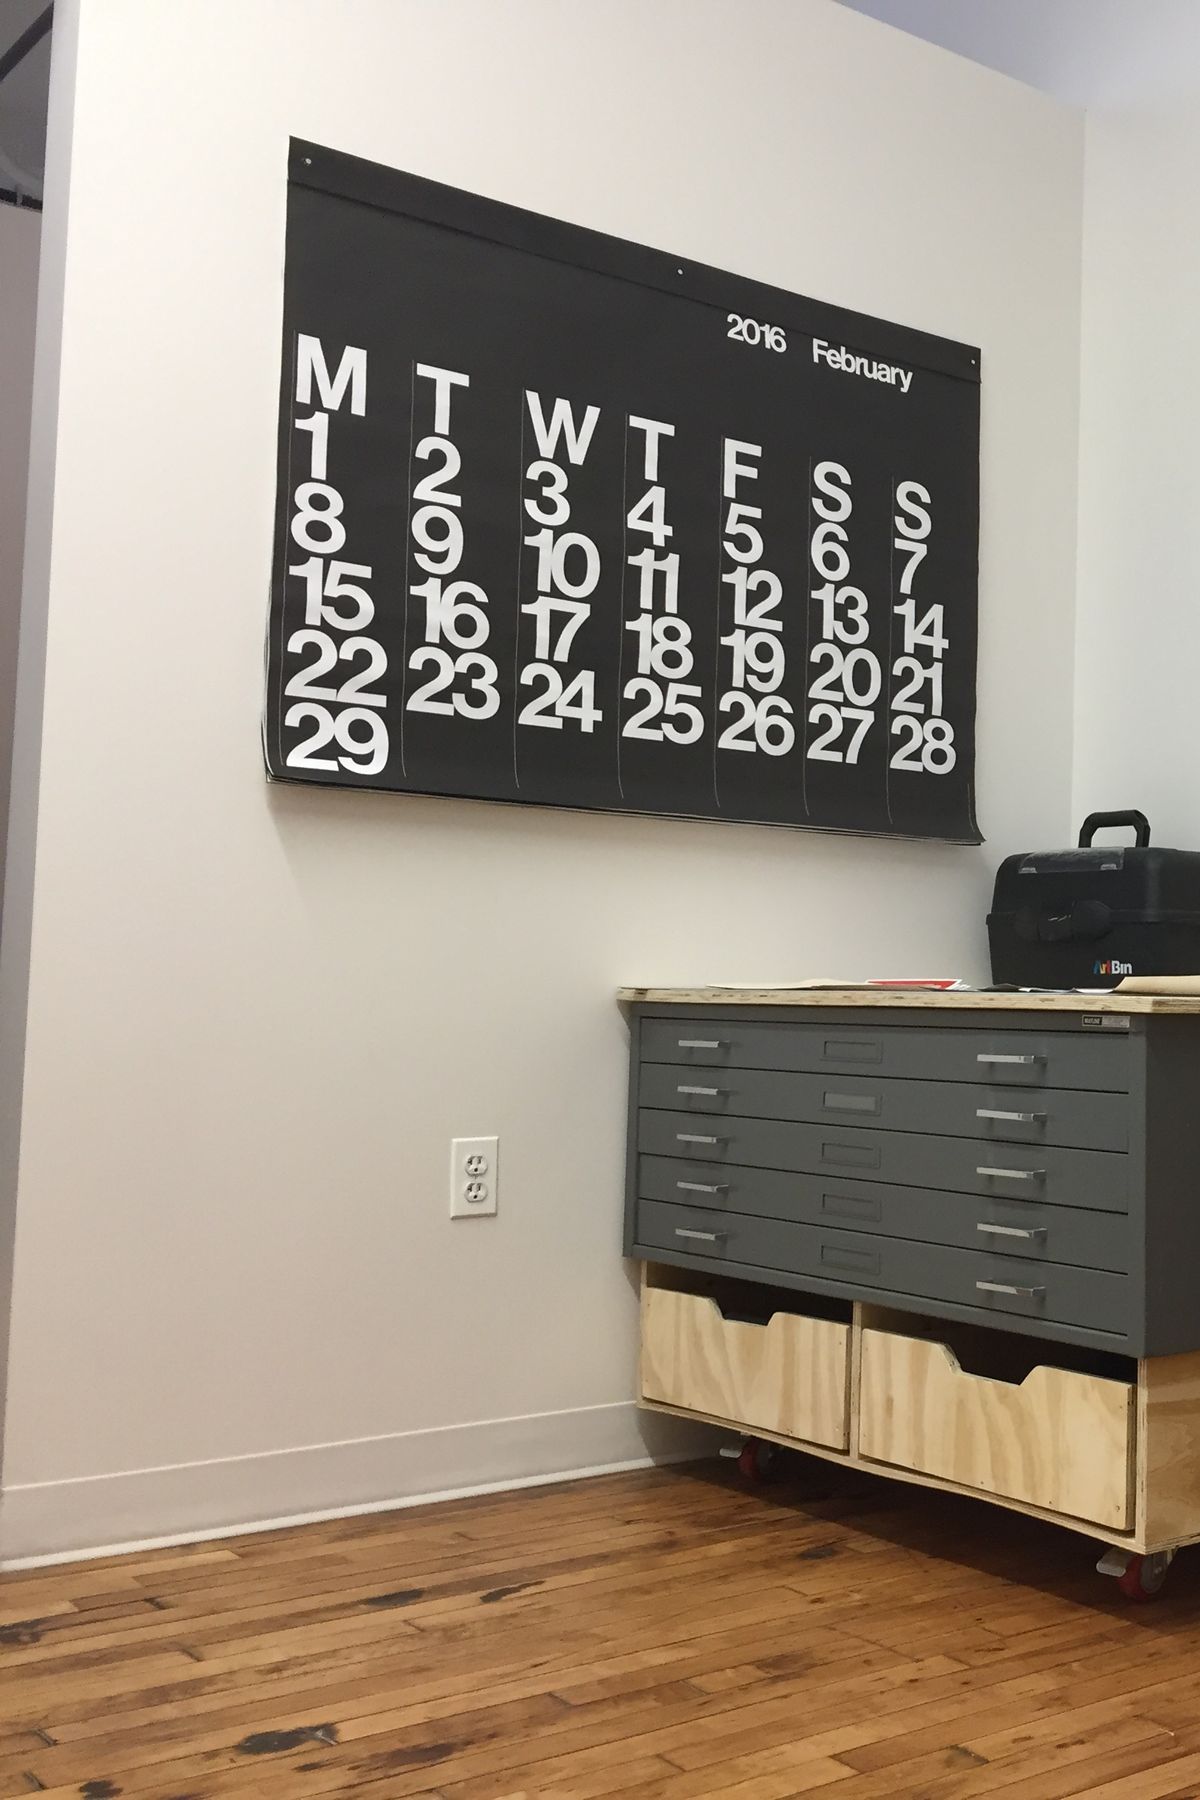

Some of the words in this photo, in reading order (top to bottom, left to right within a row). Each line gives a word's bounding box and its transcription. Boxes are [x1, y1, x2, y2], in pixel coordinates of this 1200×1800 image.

[727, 314, 787, 353] 2016
[813, 338, 913, 393] February
[295, 411, 328, 480] 1
[413, 437, 461, 507] 2
[524, 461, 570, 526] 3
[627, 486, 673, 546] 4
[723, 503, 763, 563] 5
[811, 522, 850, 581] 6
[895, 538, 927, 594] 7
[296, 333, 367, 416] M
[417, 363, 469, 435] T
[526, 390, 600, 465] W
[629, 415, 675, 481] T
[724, 438, 762, 498] F
[812, 462, 852, 522] S
[895, 481, 931, 541] S
[289, 557, 374, 631] 15
[410, 577, 489, 649] 16
[521, 596, 590, 662] 17
[626, 613, 693, 679] 18
[720, 629, 785, 692] 19
[808, 643, 881, 706] 20
[891, 656, 942, 716] 21
[291, 482, 346, 554] 8
[412, 505, 463, 574] 9
[524, 528, 600, 598] 10
[628, 548, 679, 614] 11
[722, 566, 783, 631] 12
[811, 583, 869, 644] 13
[894, 599, 948, 658] 14
[285, 629, 387, 707] 22
[406, 647, 500, 719] 23
[518, 663, 602, 732] 24
[622, 678, 704, 744] 25
[718, 691, 795, 756] 26
[807, 703, 874, 764] 27
[890, 715, 956, 774] 28
[285, 702, 389, 775] 29
